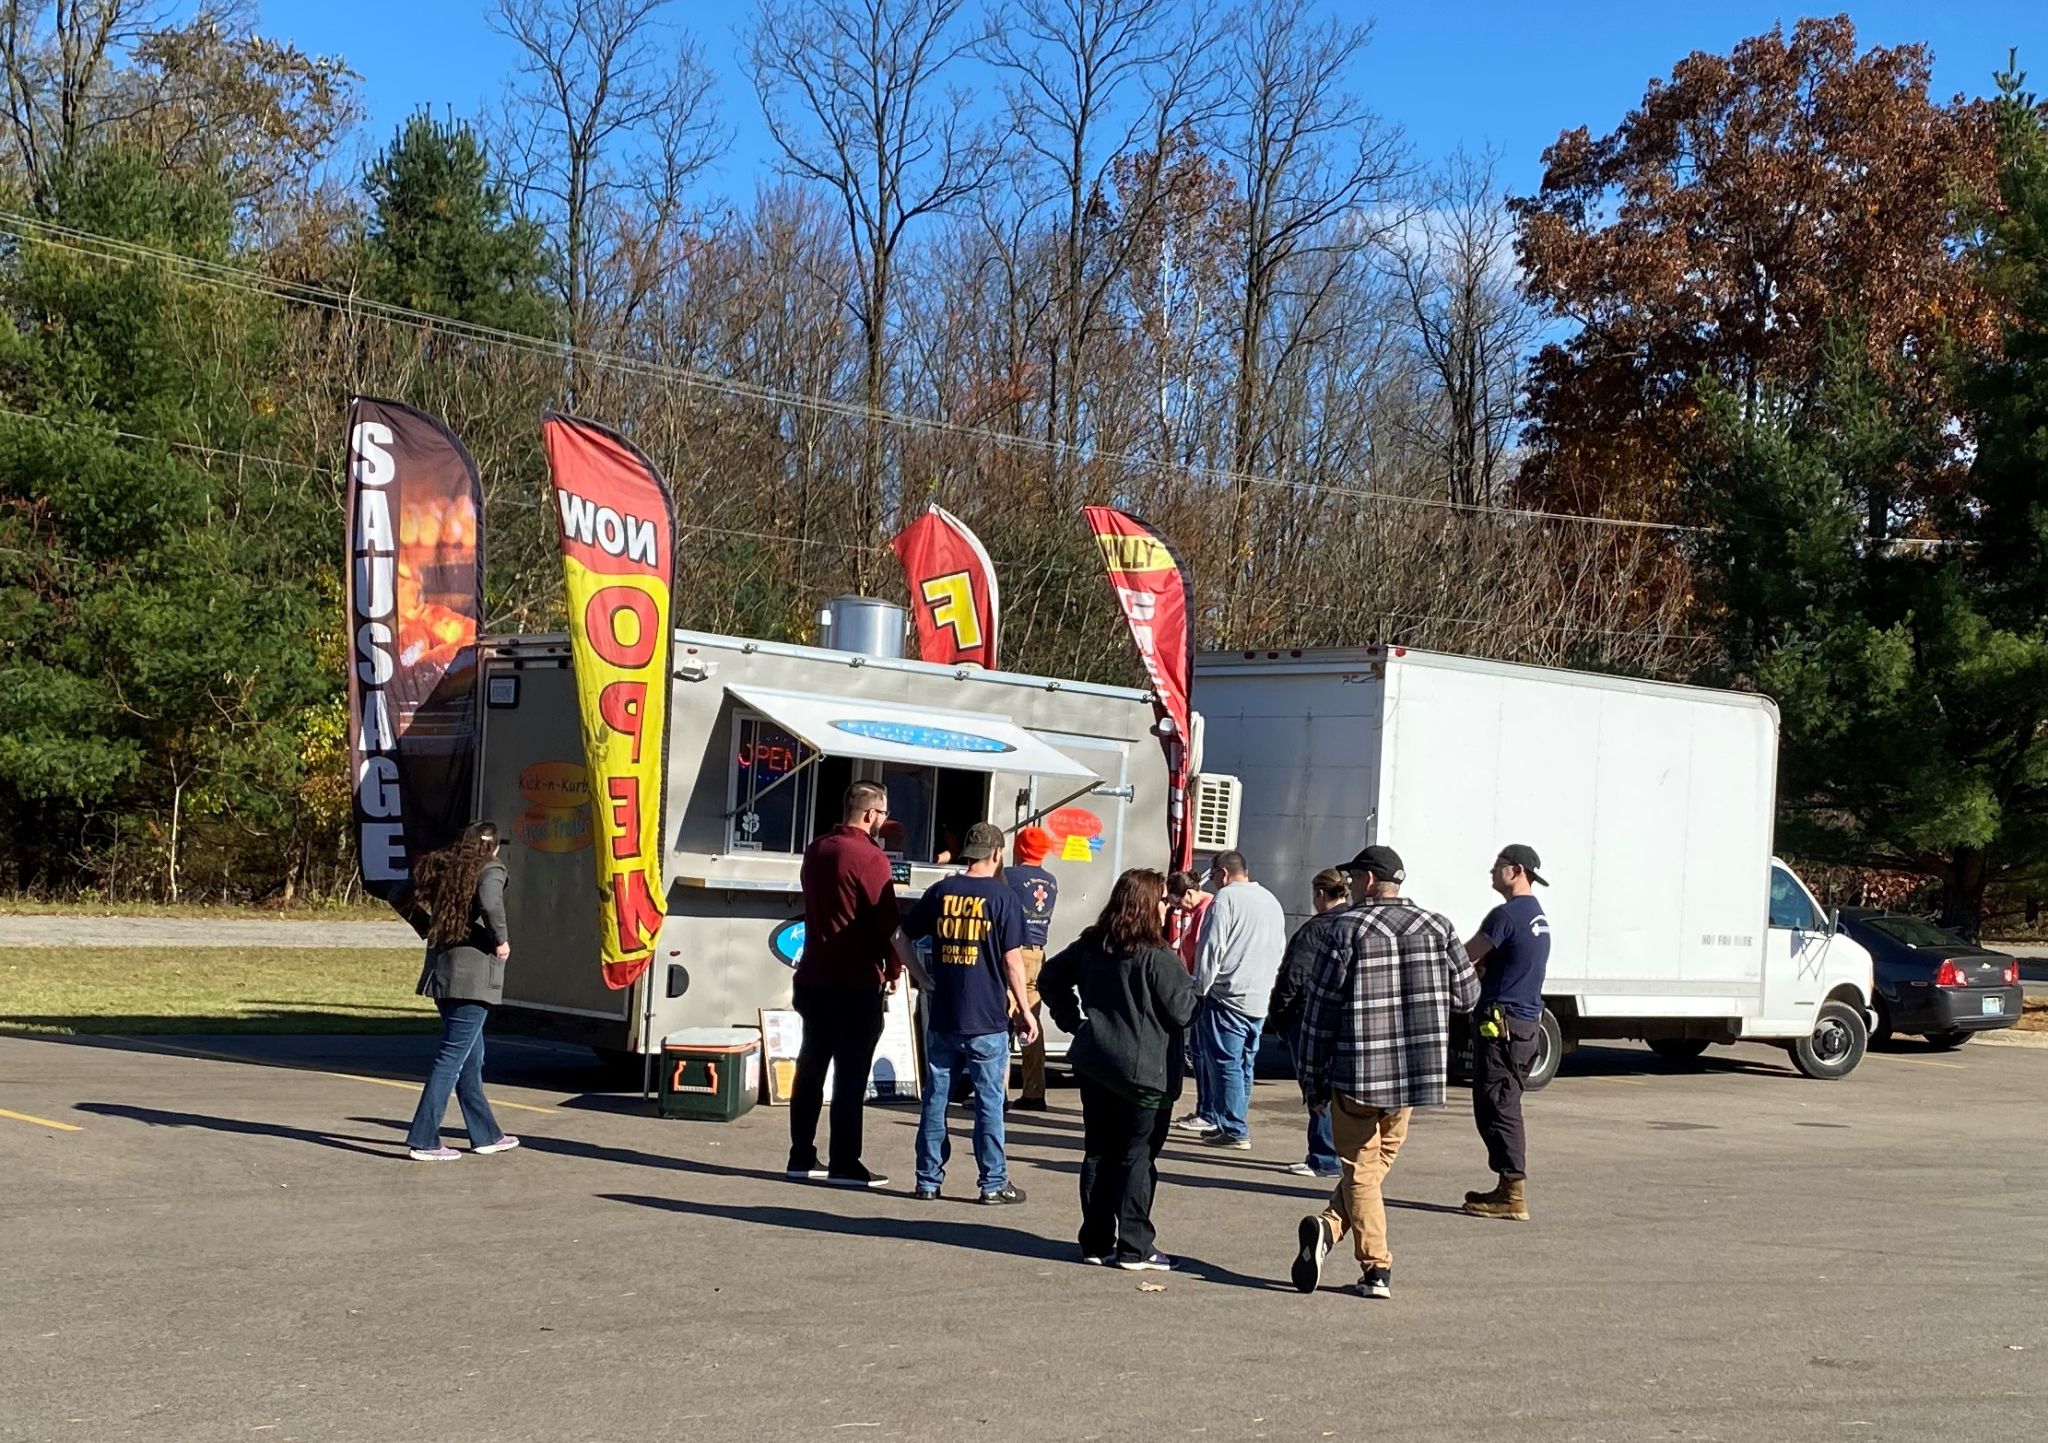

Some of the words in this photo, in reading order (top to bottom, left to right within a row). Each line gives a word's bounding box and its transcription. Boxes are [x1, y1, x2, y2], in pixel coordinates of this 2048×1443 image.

[352, 421, 409, 881] SAUSAGE
[737, 743, 796, 771] OPEN
[943, 894, 986, 918] TUCK
[937, 916, 992, 941] COMIN'
[942, 944, 960, 955] FOR
[942, 954, 978, 966] BUYOUT
